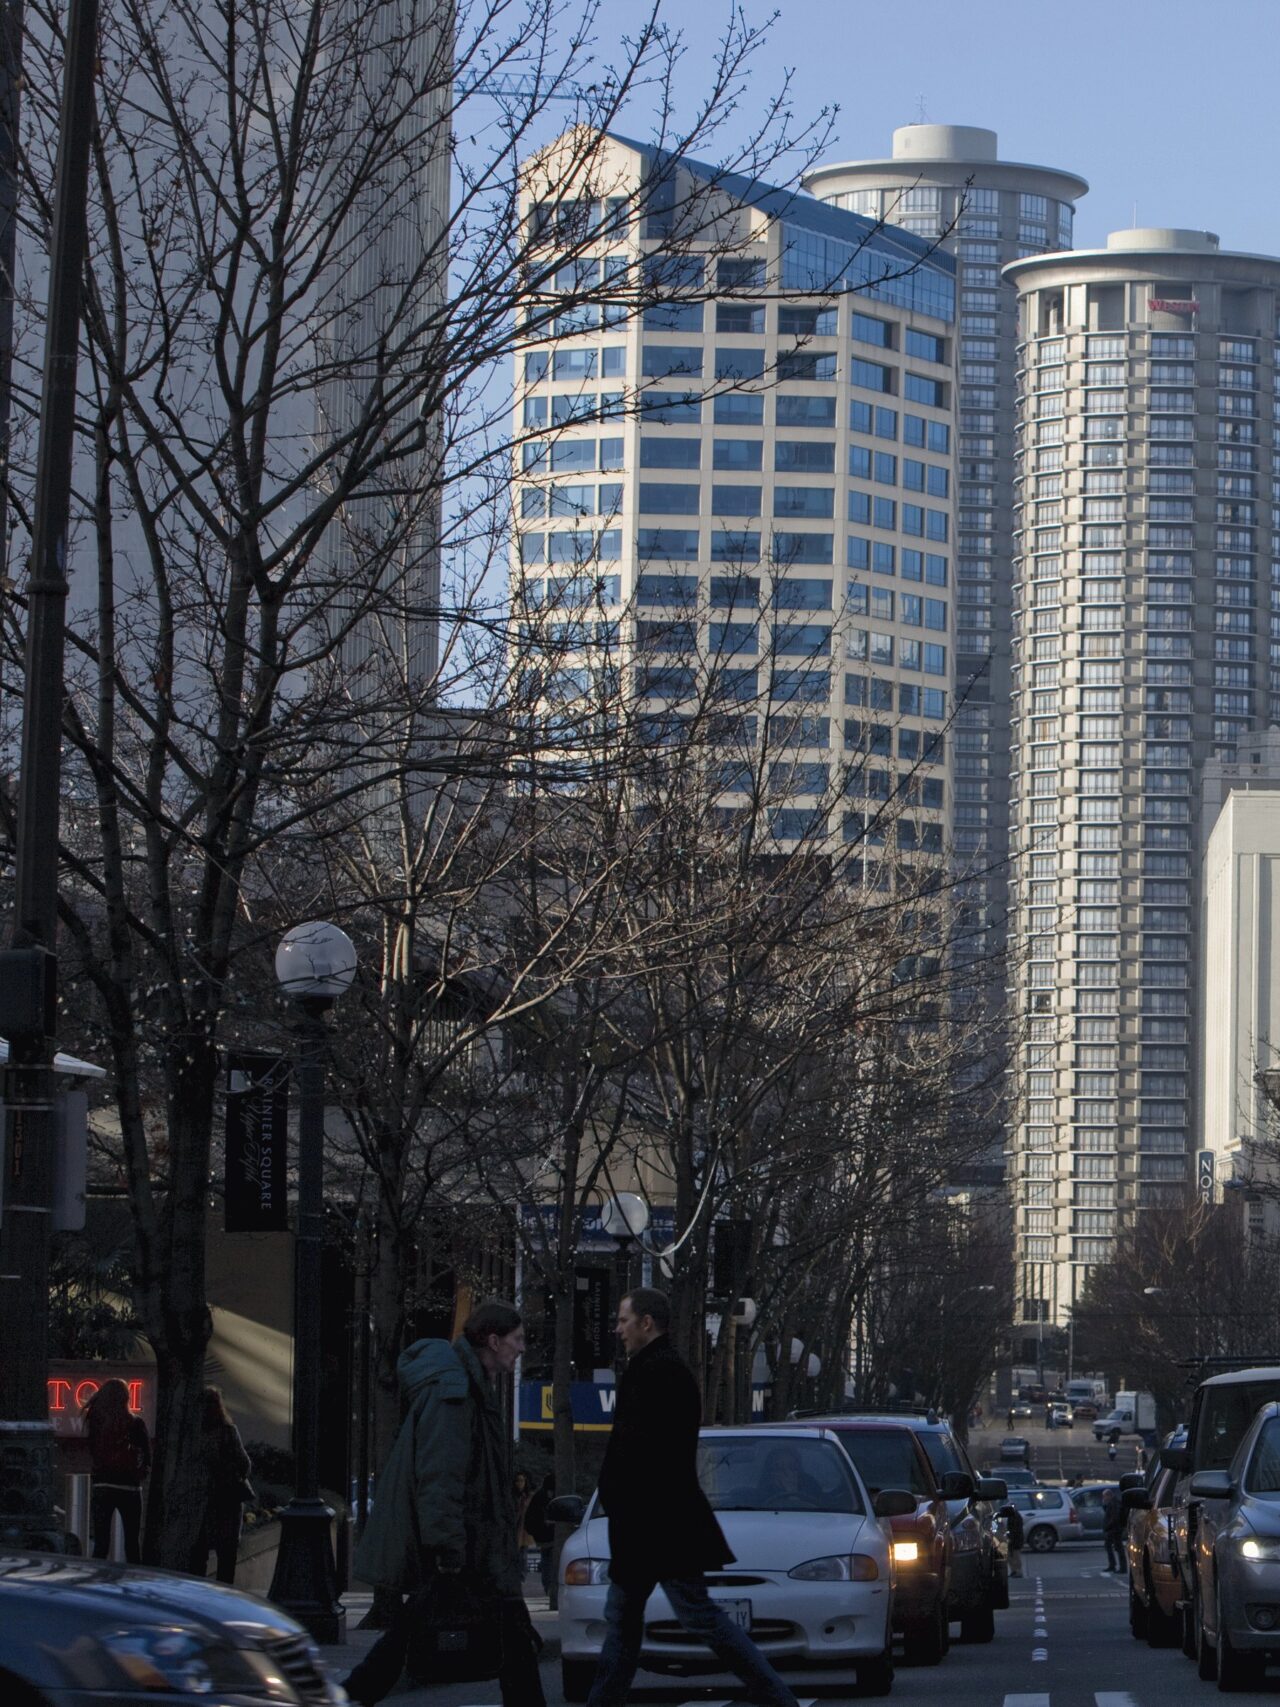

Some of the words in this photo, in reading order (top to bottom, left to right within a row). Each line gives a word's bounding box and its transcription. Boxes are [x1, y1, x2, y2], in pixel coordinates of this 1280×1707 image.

[1148, 299, 1200, 313] WESTIN
[261, 1077, 273, 1141] RAINIER
[261, 1146, 272, 1210] SQUARE
